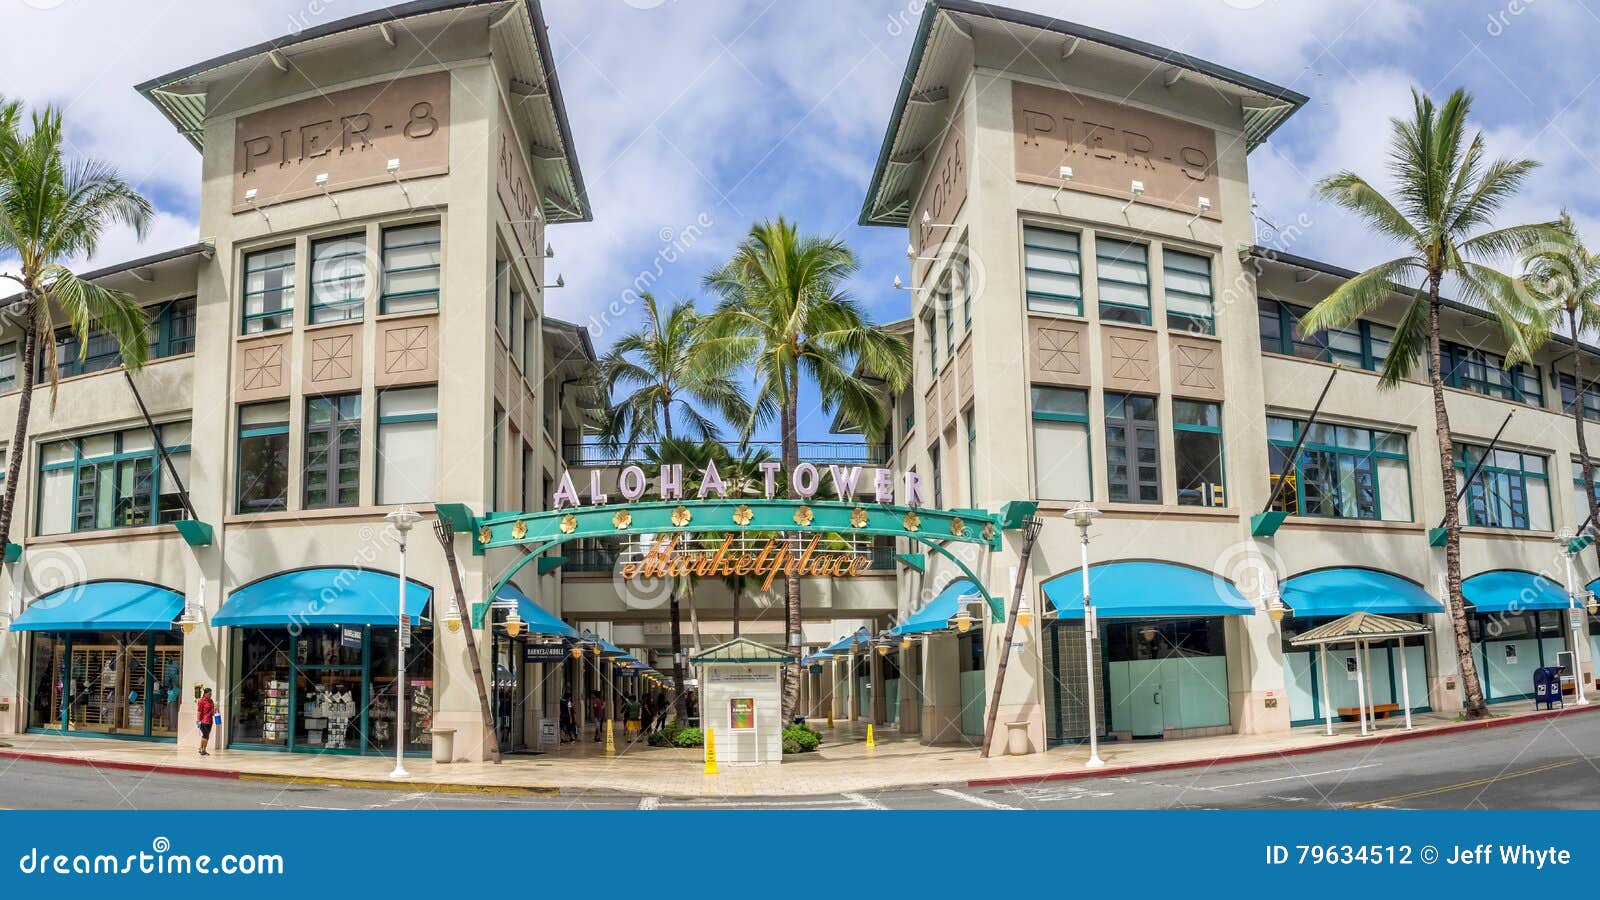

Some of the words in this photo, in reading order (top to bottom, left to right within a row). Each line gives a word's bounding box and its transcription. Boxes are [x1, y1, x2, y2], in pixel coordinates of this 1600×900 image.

[553, 458, 728, 508] ALOHA
[759, 461, 924, 505] TOWER
[622, 532, 874, 592] Marketplace
